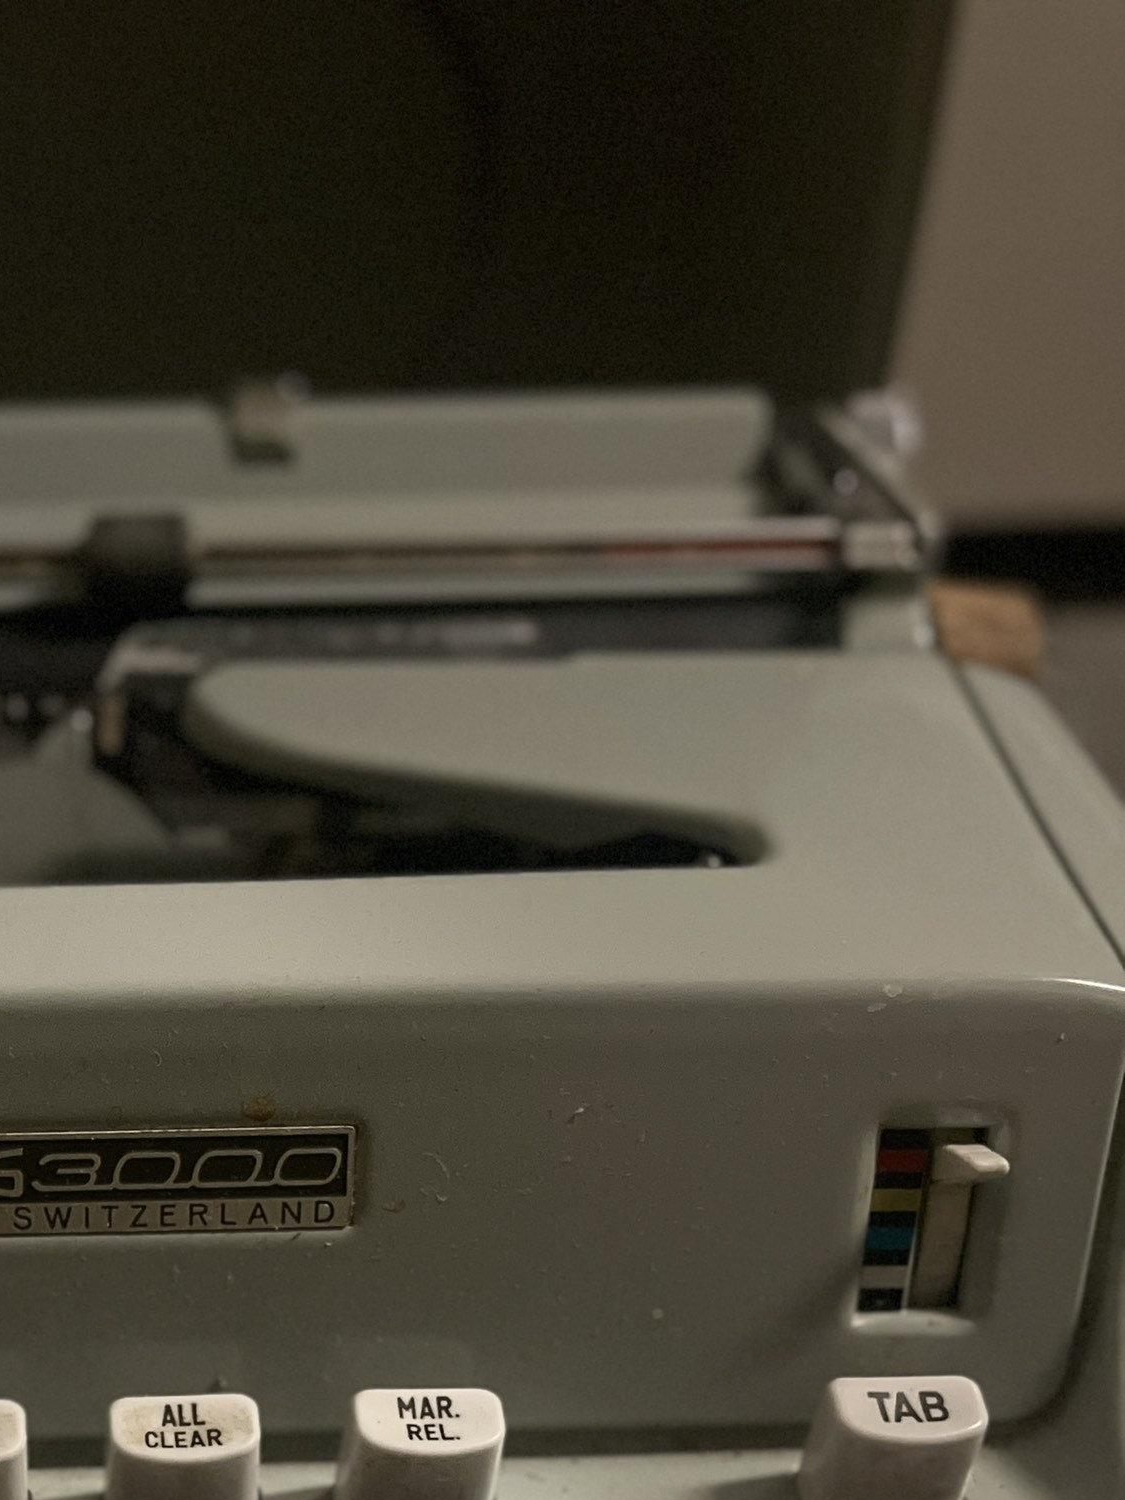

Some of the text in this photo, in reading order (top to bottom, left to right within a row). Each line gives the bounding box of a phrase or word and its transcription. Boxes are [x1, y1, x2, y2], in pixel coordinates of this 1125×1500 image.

[30, 1147, 344, 1192] 3000
[13, 1200, 338, 1230] SWITZERLAND
[161, 1402, 207, 1428] ALL
[396, 1395, 461, 1420] MAR.
[867, 1390, 950, 1423] TAB
[144, 1428, 223, 1449] CLEAR
[406, 1423, 462, 1442] REL.
